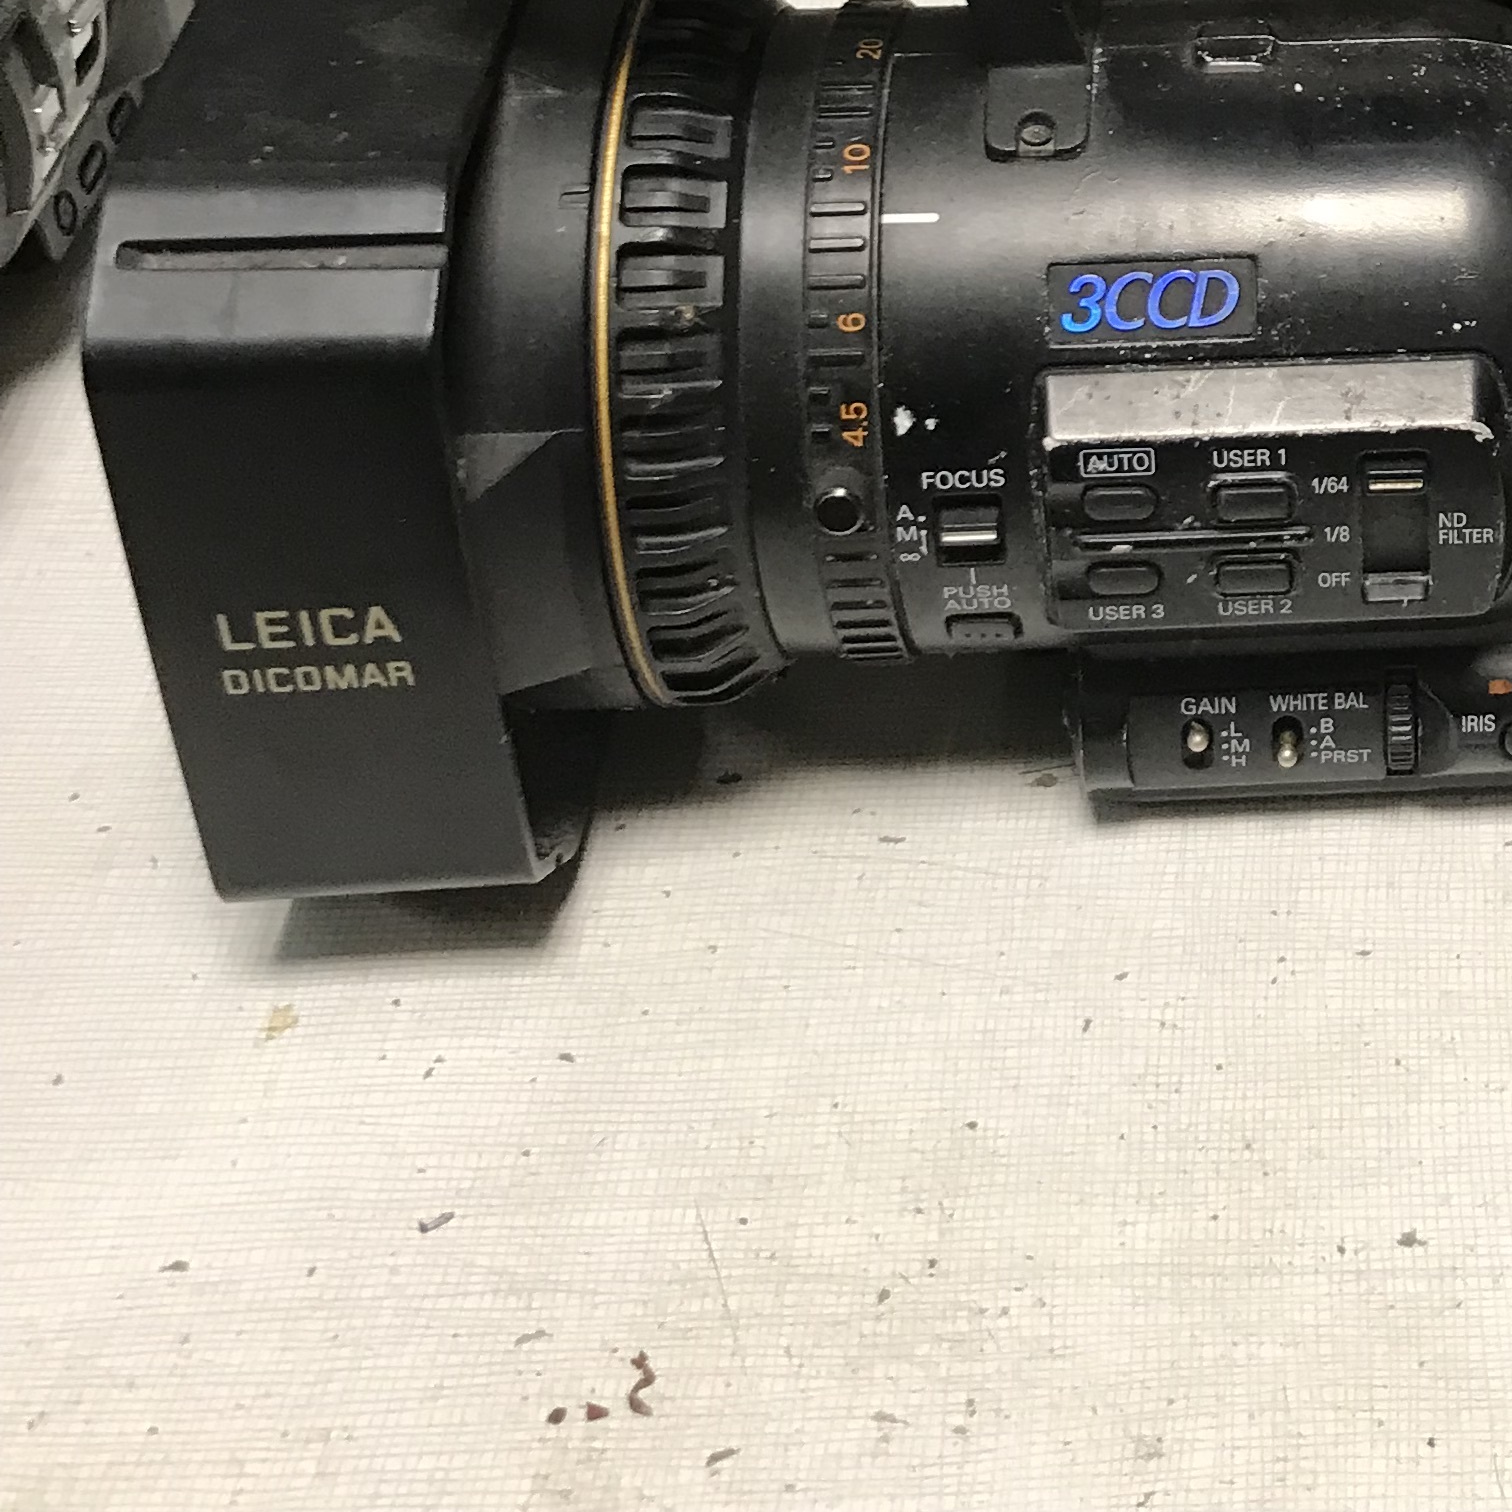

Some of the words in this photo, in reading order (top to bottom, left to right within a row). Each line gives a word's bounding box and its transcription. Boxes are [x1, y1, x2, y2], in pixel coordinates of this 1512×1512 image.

[855, 38, 884, 60] 20
[841, 143, 871, 174] 10
[1060, 268, 1241, 333] 3CCD
[836, 312, 866, 333] 6
[839, 402, 868, 447] 4.5
[1086, 452, 1150, 473] AUTO
[1212, 449, 1271, 469] USER
[1277, 448, 1287, 467] 1
[921, 468, 1006, 490] FOCUS
[1311, 476, 1350, 495] 1/64
[896, 504, 915, 522] A
[1438, 512, 1467, 528] ND
[896, 525, 918, 542] M
[1324, 525, 1350, 543] 1/8
[1438, 528, 1494, 545] FILTER
[1317, 572, 1350, 588] OFF
[943, 584, 1009, 599] PUSH
[944, 597, 1012, 610] AUTO
[1088, 605, 1146, 621] USER
[1151, 603, 1166, 619] 3
[1217, 599, 1274, 616] USER
[1279, 598, 1293, 614] 2
[216, 605, 402, 651] LEICA
[222, 660, 416, 695] DICOMAR
[1180, 696, 1236, 715] GAIN
[1269, 693, 1328, 712] WHITE
[1334, 691, 1369, 709] BAL
[1229, 721, 1242, 737] L
[1320, 717, 1334, 733] B
[1461, 713, 1496, 733] IRIS
[1230, 738, 1250, 753] M
[1320, 735, 1336, 749] A
[1231, 754, 1246, 767] H
[1321, 749, 1372, 763] PRST
